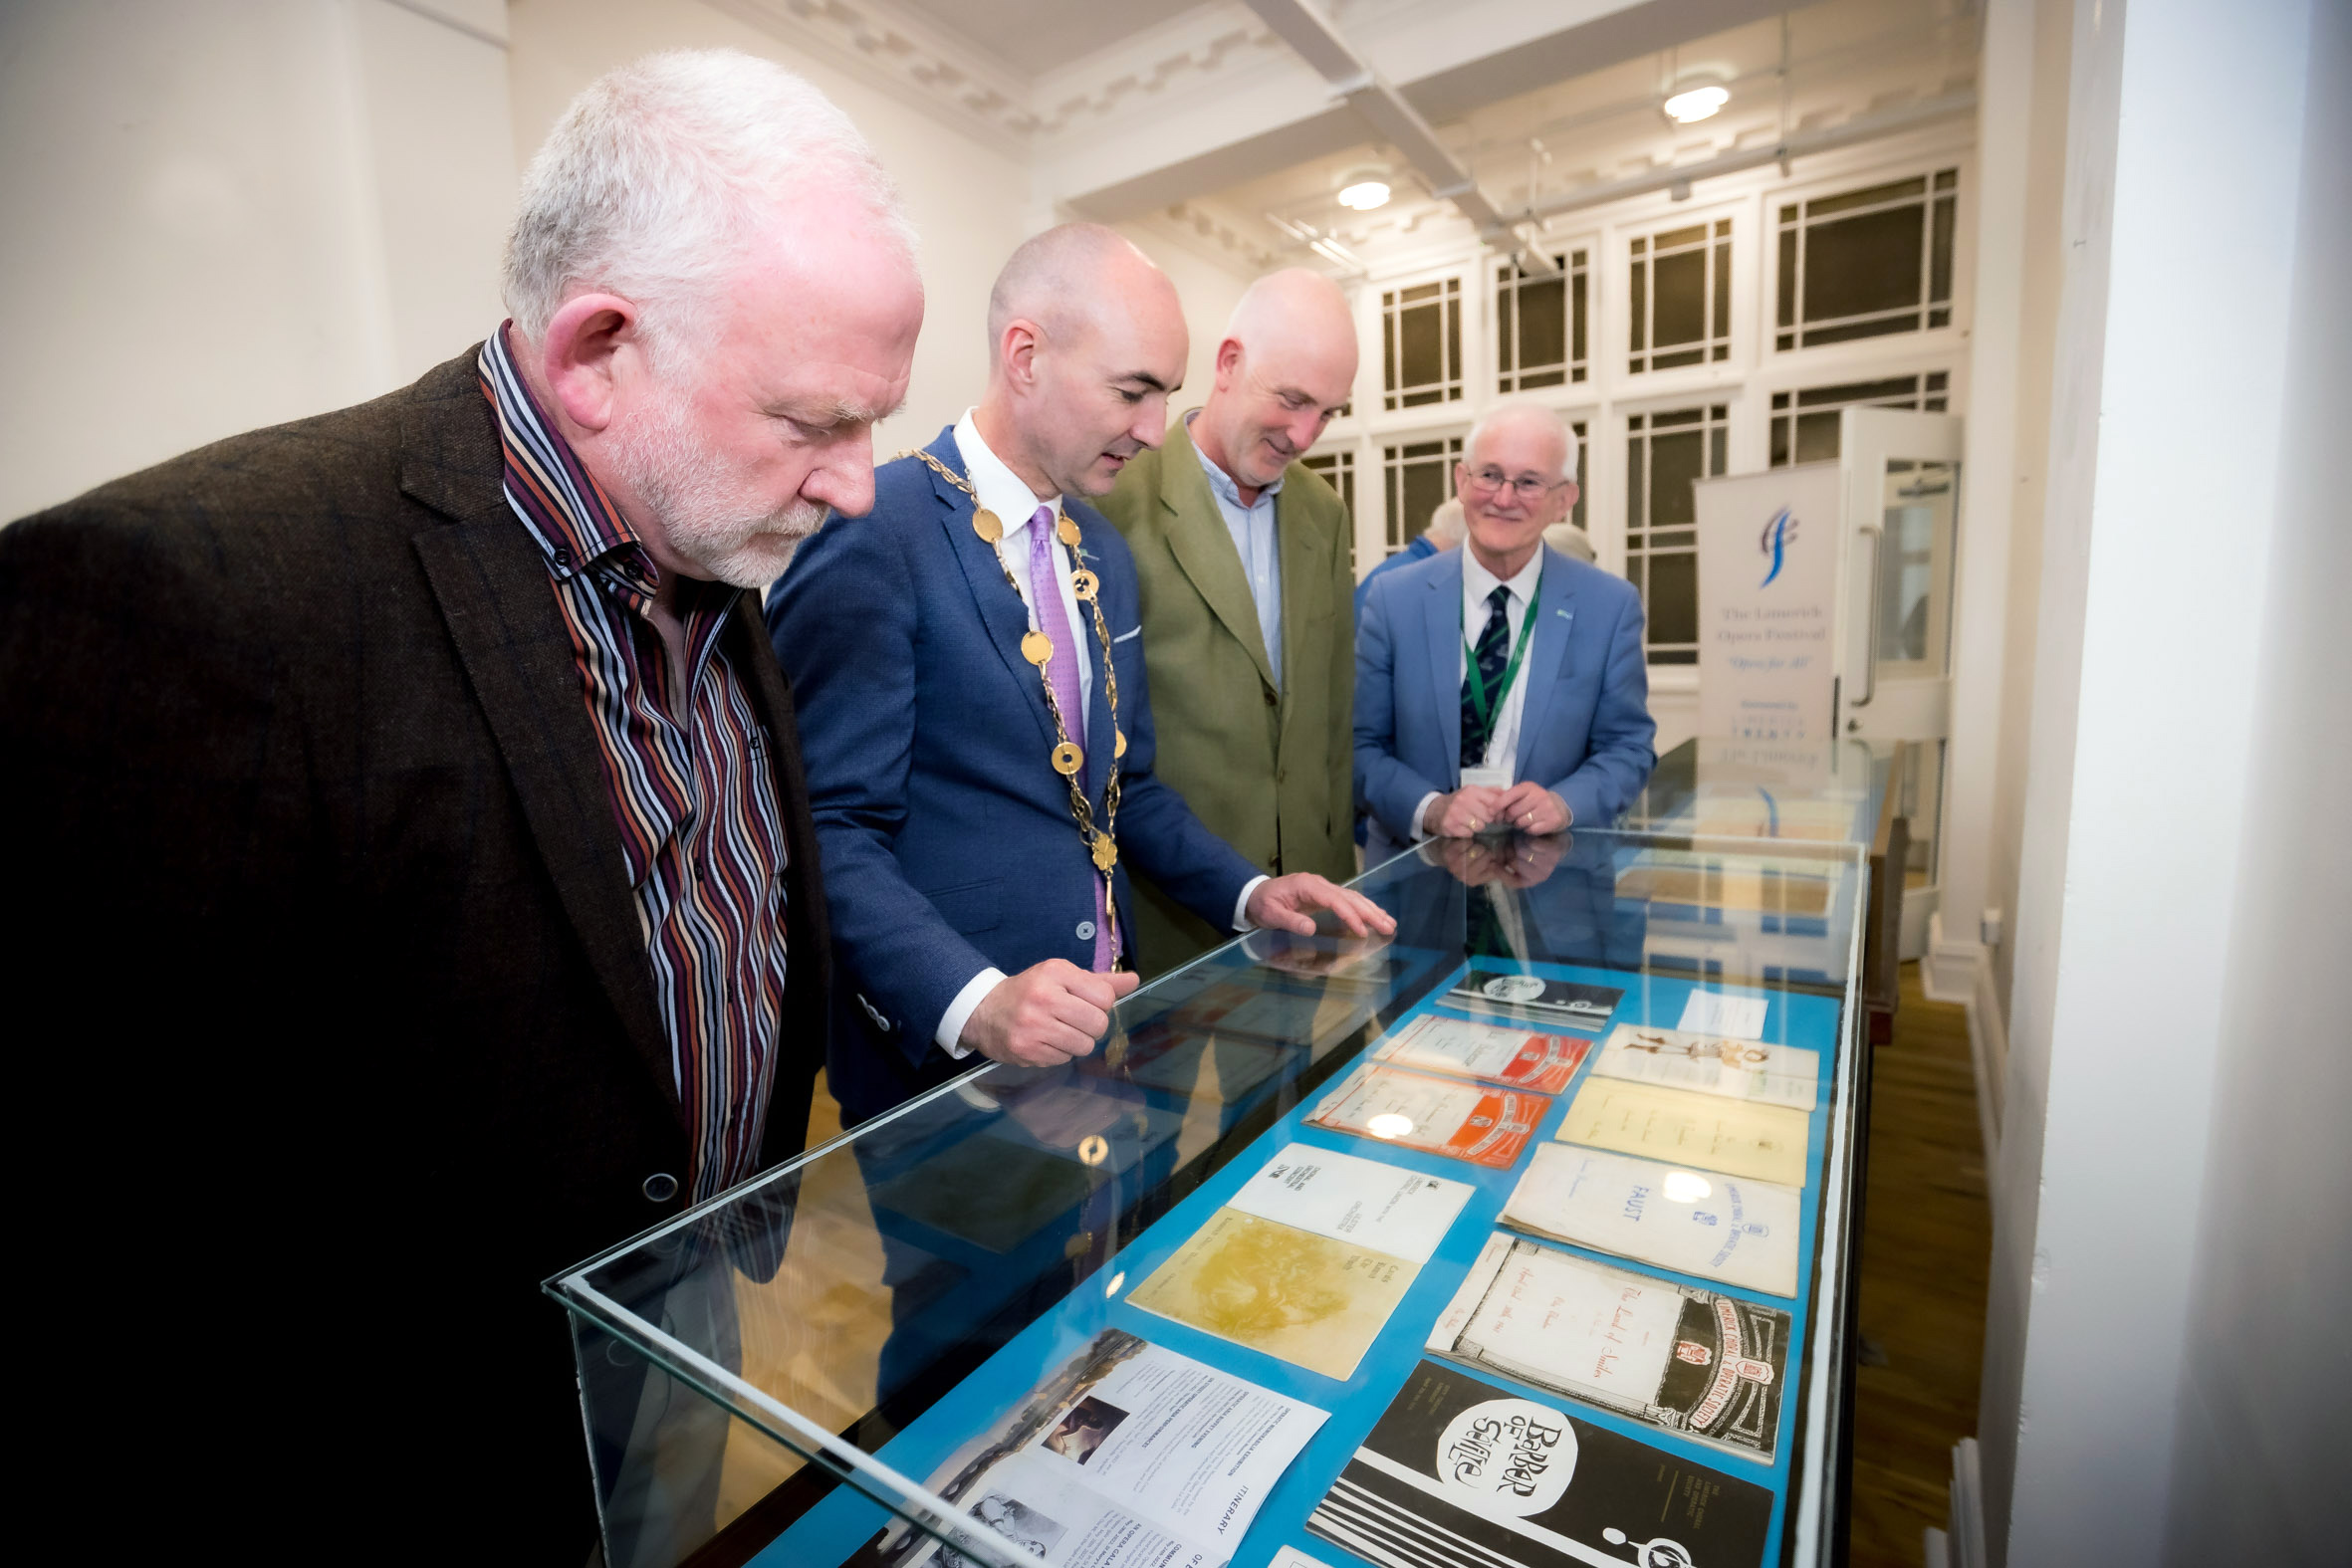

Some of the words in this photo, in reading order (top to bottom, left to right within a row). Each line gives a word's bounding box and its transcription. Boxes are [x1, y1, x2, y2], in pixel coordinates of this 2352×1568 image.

[1622, 1185, 1649, 1222] FAUST
[1620, 1285, 1641, 1304] The
[1610, 1305, 1633, 1331] Land
[1717, 1302, 1736, 1330] LIMERICK
[1602, 1330, 1624, 1344] of
[1724, 1333, 1737, 1358] CHORAL
[1591, 1345, 1621, 1383] Smiles
[1196, 1382, 1210, 1394] STREET
[1711, 1367, 1735, 1399] OPERATIC
[1178, 1393, 1198, 1409] OPERATIC
[1230, 1390, 1250, 1408] OPERATIC
[1170, 1408, 1181, 1418] ARIA
[1222, 1407, 1233, 1416] ARIA
[1272, 1407, 1292, 1425] OPERATIC
[1692, 1397, 1721, 1426] SOCIETY
[1140, 1417, 1173, 1448] PERFORMANCES
[1208, 1416, 1224, 1430] BUFFET
[1190, 1430, 1211, 1449] EVENING
[1248, 1424, 1275, 1451] MEMORABILIA
[1227, 1451, 1251, 1476] EXHIBITION
[1217, 1484, 1249, 1534] ITINERARY
[1132, 1522, 1142, 1531] AN
[1116, 1528, 1135, 1549] OPERA
[1102, 1548, 1120, 1566] GALA
[1189, 1553, 1202, 1565] OF
